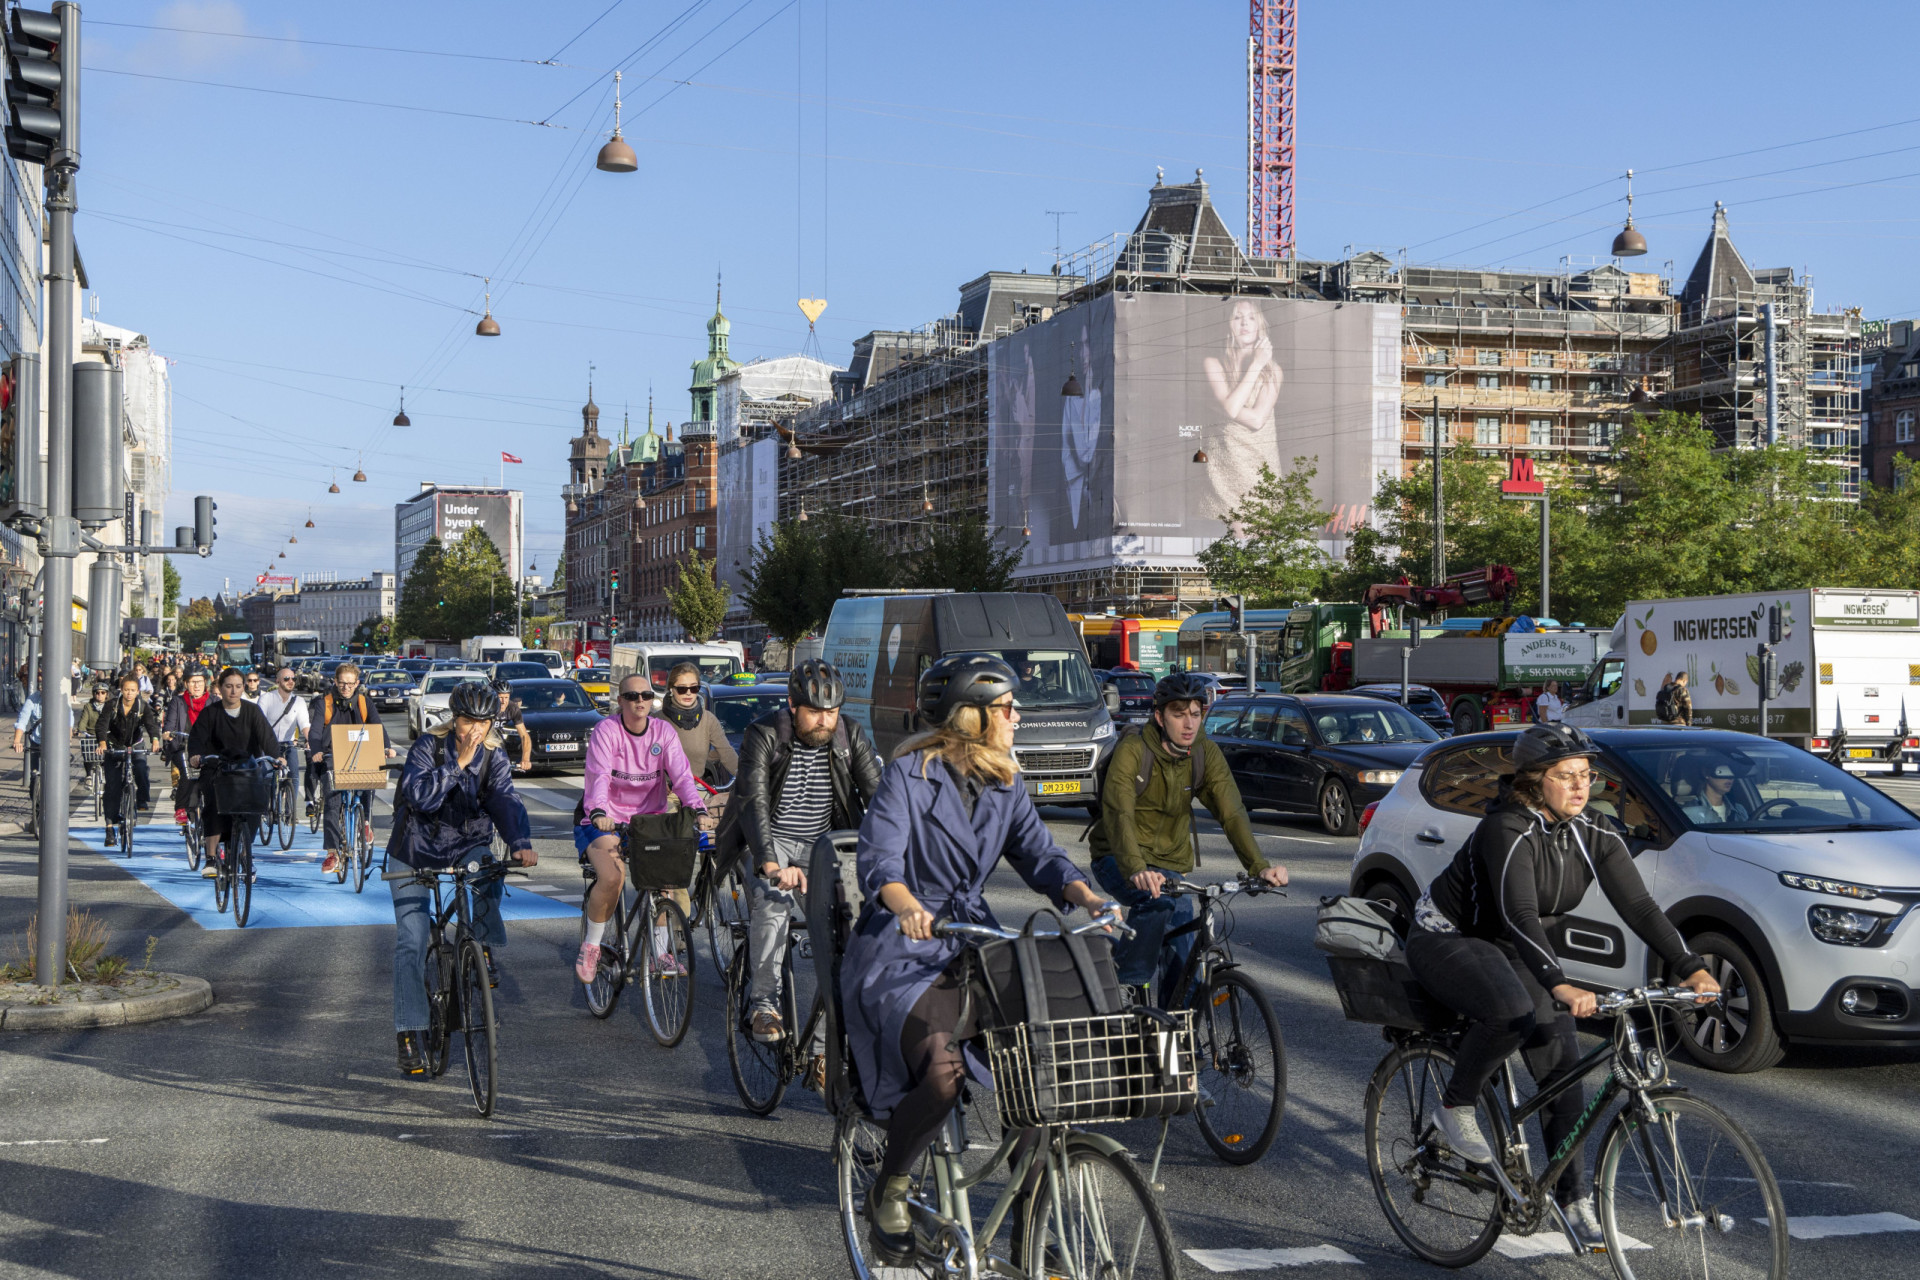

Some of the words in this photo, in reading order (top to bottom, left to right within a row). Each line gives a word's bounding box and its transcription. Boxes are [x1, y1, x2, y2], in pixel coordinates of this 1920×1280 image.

[444, 504, 480, 514] Under
[444, 516, 472, 529] byen
[1324, 503, 1368, 534] H&M
[444, 530, 463, 540] der
[1844, 604, 1886, 615] INGWERSEN
[1673, 616, 1758, 642] INGWERSEN
[1520, 639, 1557, 657] ANDERS
[1560, 640, 1578, 656] BAY
[834, 652, 847, 667] HELT
[848, 652, 870, 668] ENKELT
[1529, 668, 1576, 677] SKÆVINGE
[855, 672, 867, 689] DIG
[1740, 715, 1750, 724] 36
[1775, 715, 1785, 723] 77
